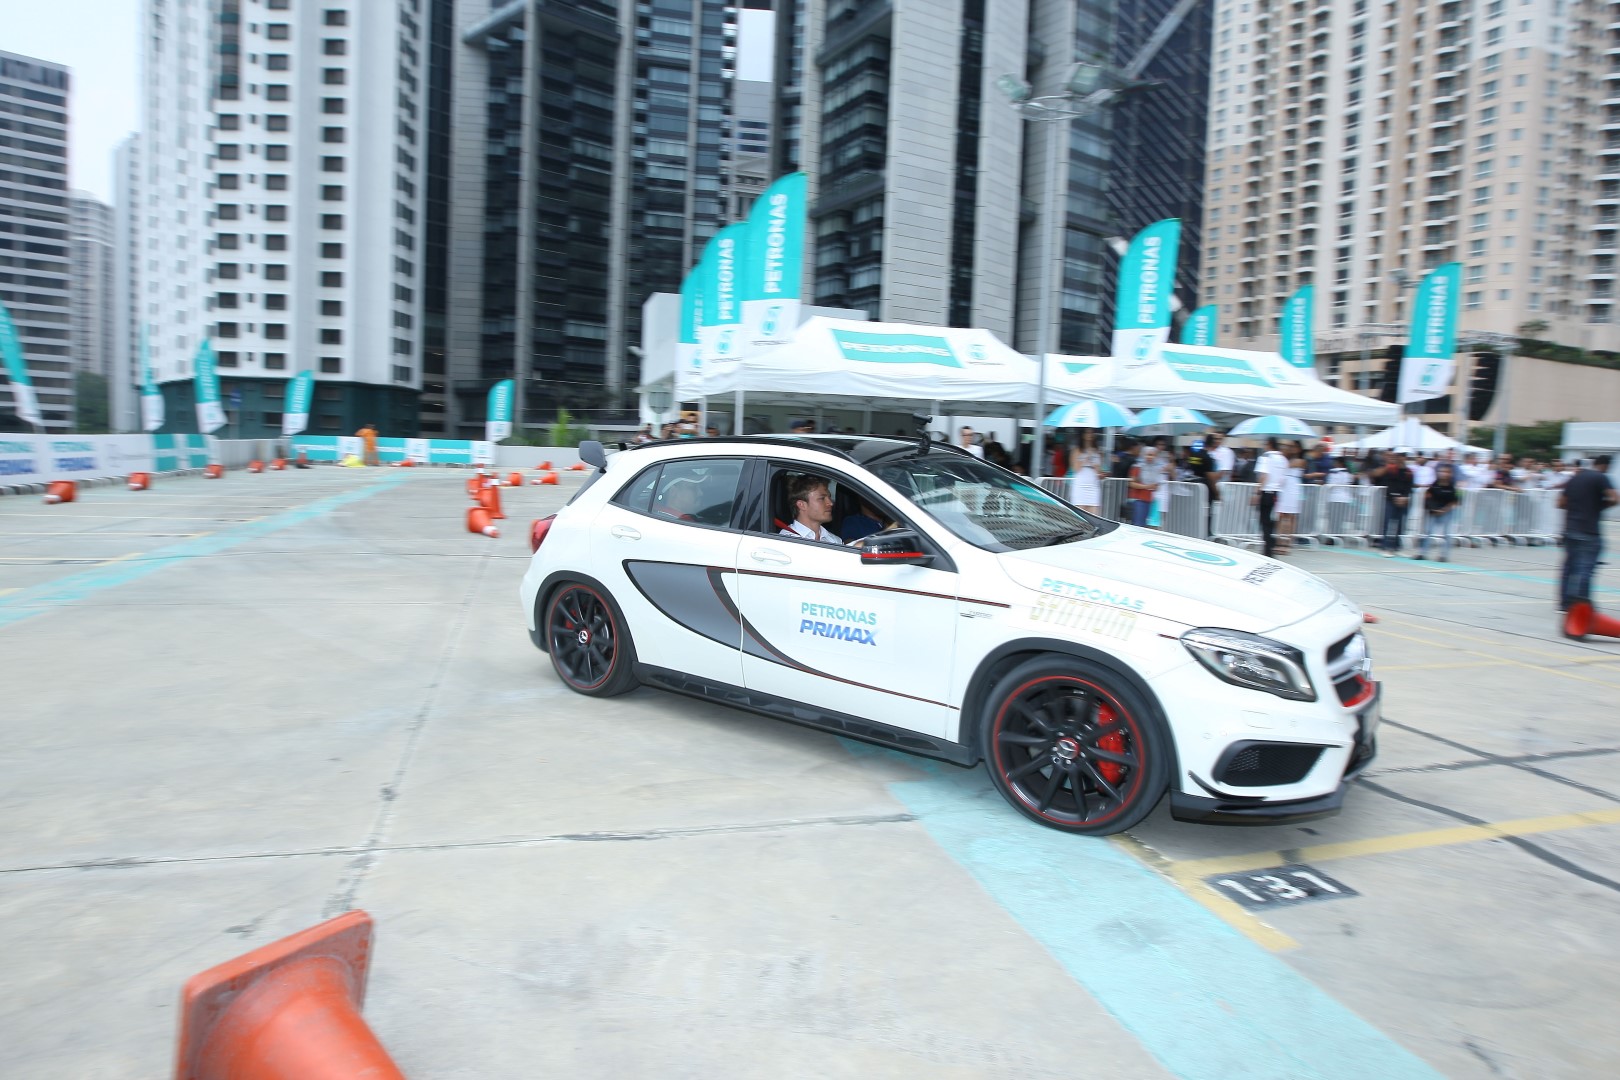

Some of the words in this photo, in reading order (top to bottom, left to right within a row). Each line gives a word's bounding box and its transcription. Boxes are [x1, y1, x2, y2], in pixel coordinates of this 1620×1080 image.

[763, 194, 788, 293] PETRONAS
[718, 238, 735, 320] PETRONAS
[1137, 237, 1162, 324] PETRONAS
[1424, 276, 1449, 354] PETRONAS
[801, 602, 877, 625] PETRONAS
[1041, 577, 1145, 610] PETRONAS
[799, 619, 879, 646] PRIMAX
[1217, 871, 1342, 902] 131
